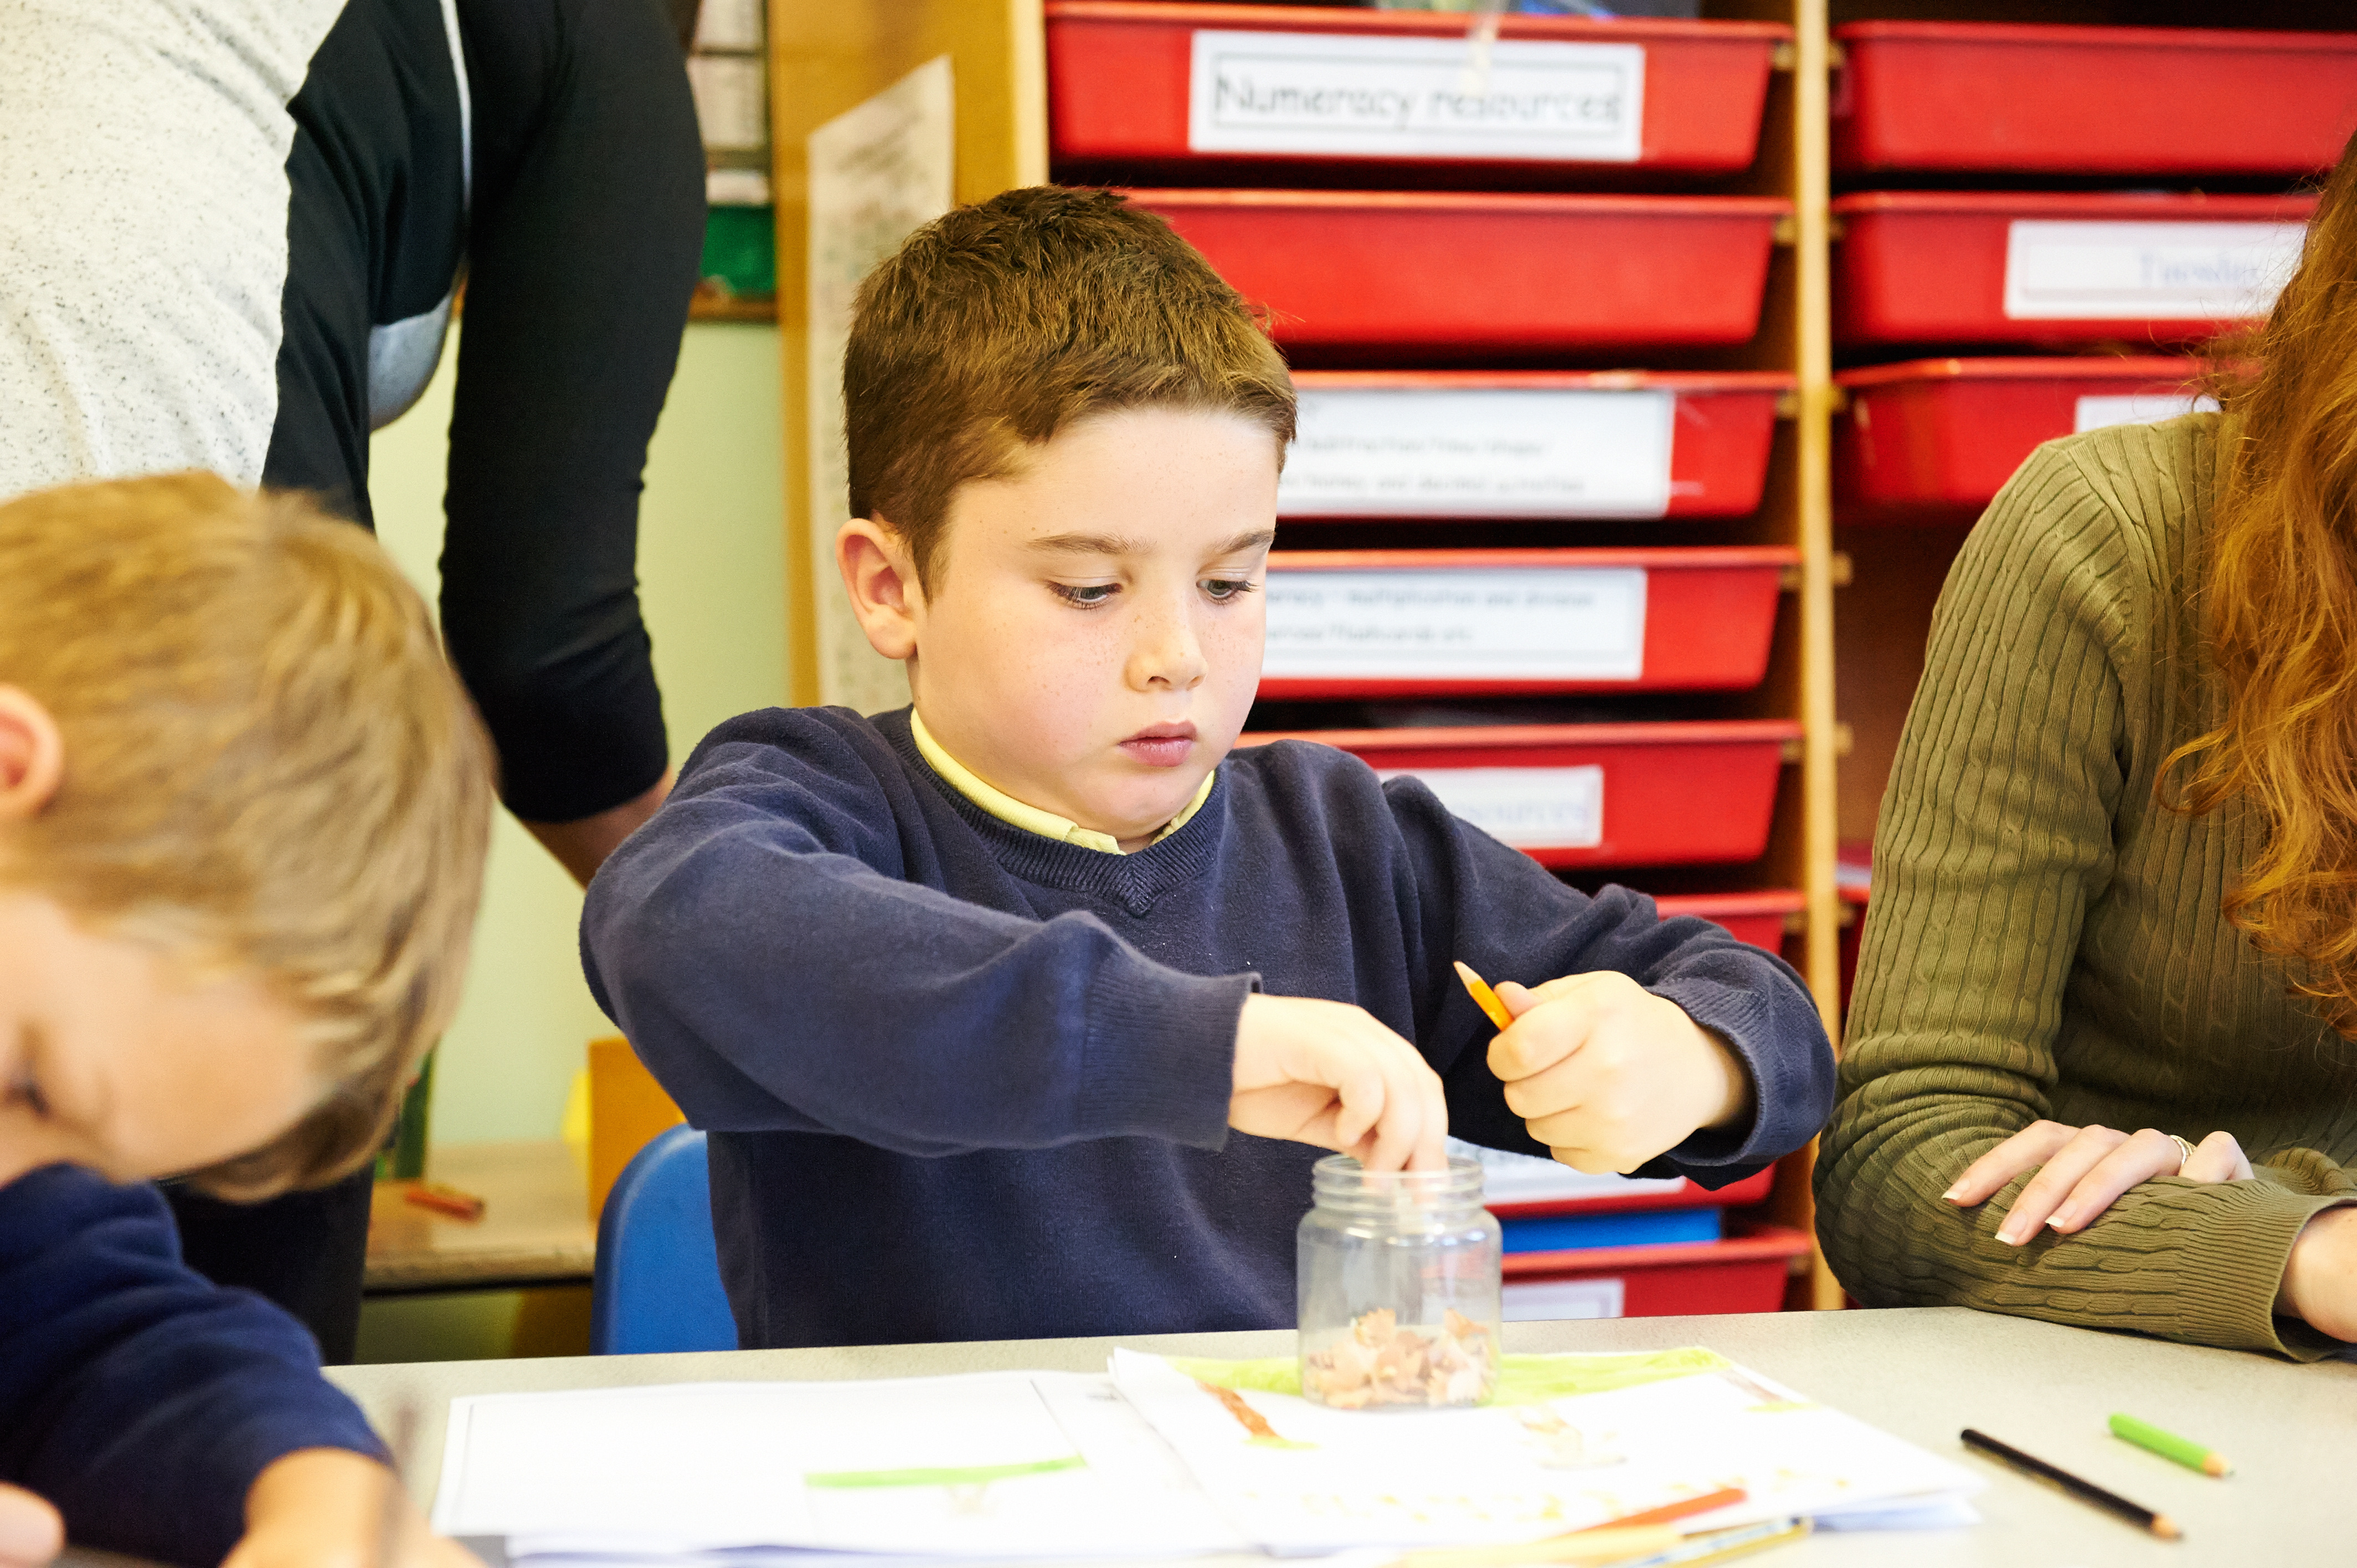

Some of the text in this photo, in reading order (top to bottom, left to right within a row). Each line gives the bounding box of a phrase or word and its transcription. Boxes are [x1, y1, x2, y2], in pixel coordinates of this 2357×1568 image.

[1214, 73, 1620, 130] Numeracy resources
[1347, 587, 1477, 610] multiplication
[1483, 588, 1517, 608] and
[1522, 588, 1596, 608] division
